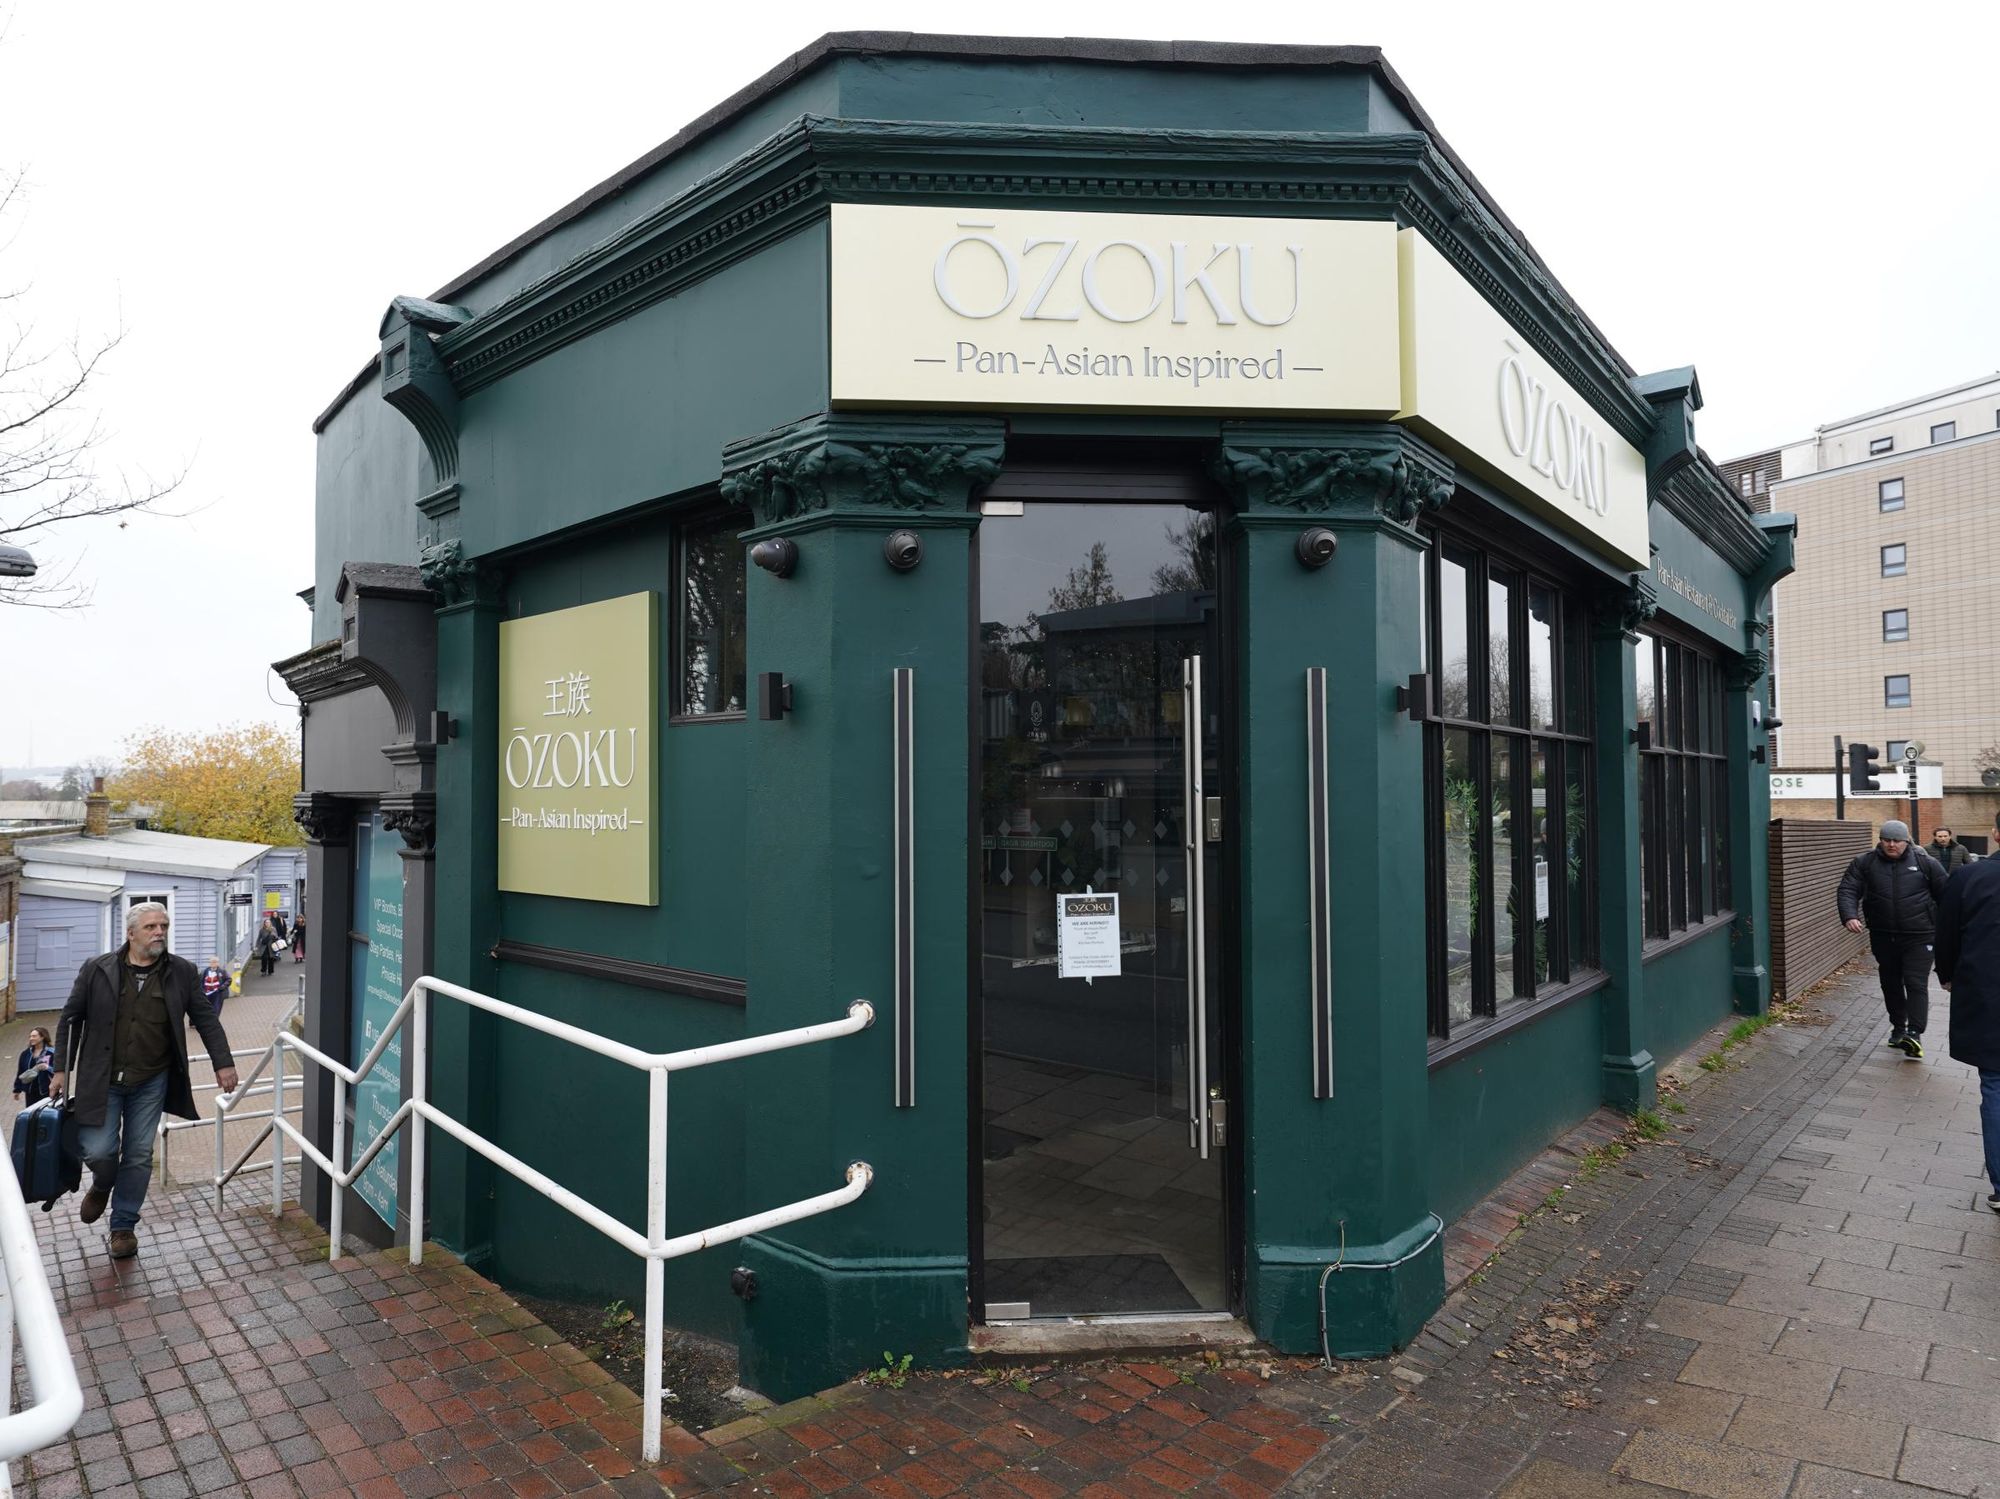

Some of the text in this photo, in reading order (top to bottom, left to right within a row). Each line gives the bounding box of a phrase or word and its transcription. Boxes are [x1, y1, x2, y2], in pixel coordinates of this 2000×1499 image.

[955, 341, 1284, 388] Pan-Asian Inspired
[543, 671, 592, 718] 王族
[1771, 777, 1803, 788] OSE
[512, 806, 628, 836] Pan-Asian Inspired
